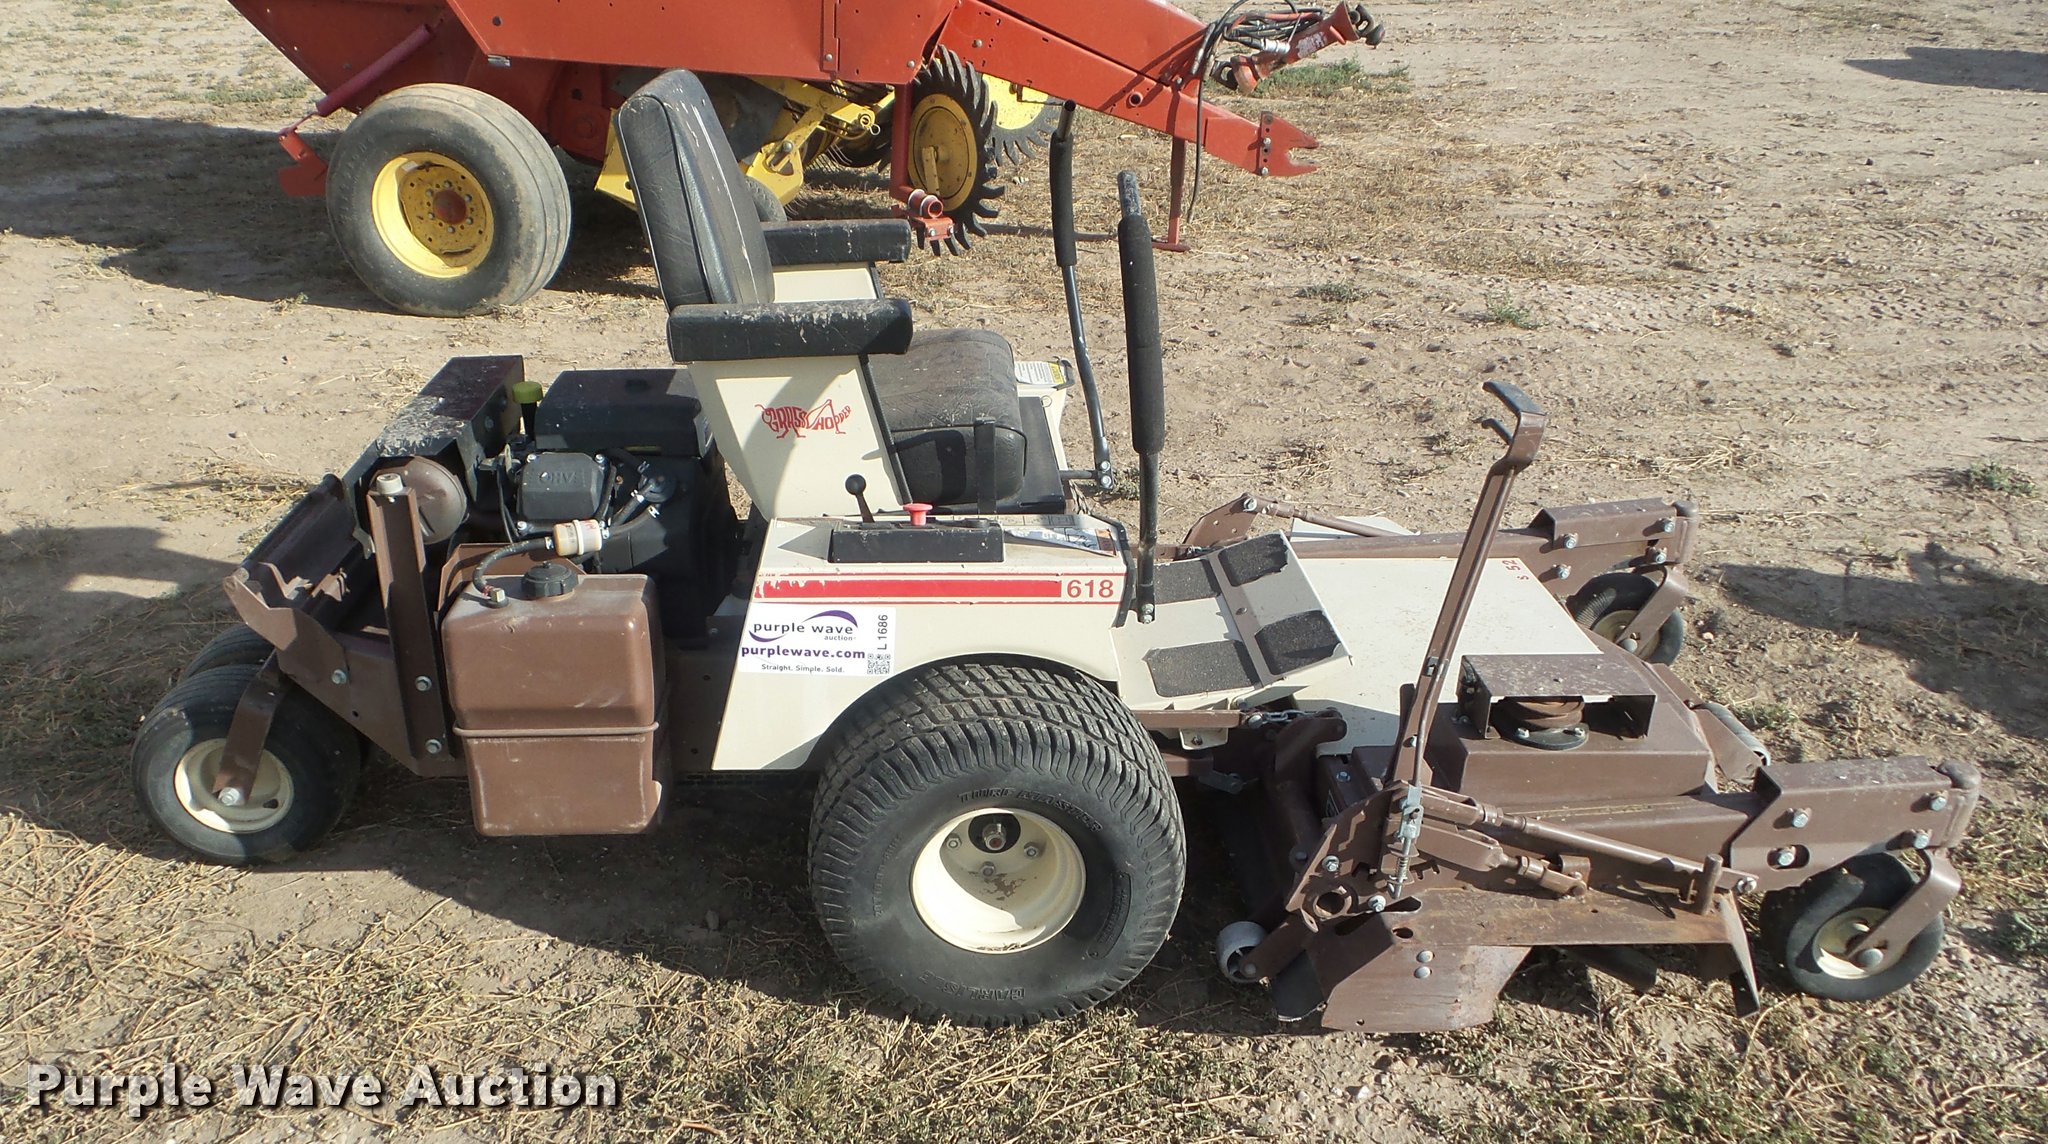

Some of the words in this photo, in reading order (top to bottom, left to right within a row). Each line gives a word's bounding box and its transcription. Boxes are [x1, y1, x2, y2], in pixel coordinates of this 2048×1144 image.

[757, 399, 852, 438] GRASSHOPPER
[1066, 579, 1114, 598] 618
[753, 622, 805, 634] purple
[811, 624, 853, 634] wave
[877, 614, 888, 641] 1686
[741, 645, 866, 659] purplewave.com
[761, 663, 793, 672] Straight.
[795, 665, 824, 673] Simple.
